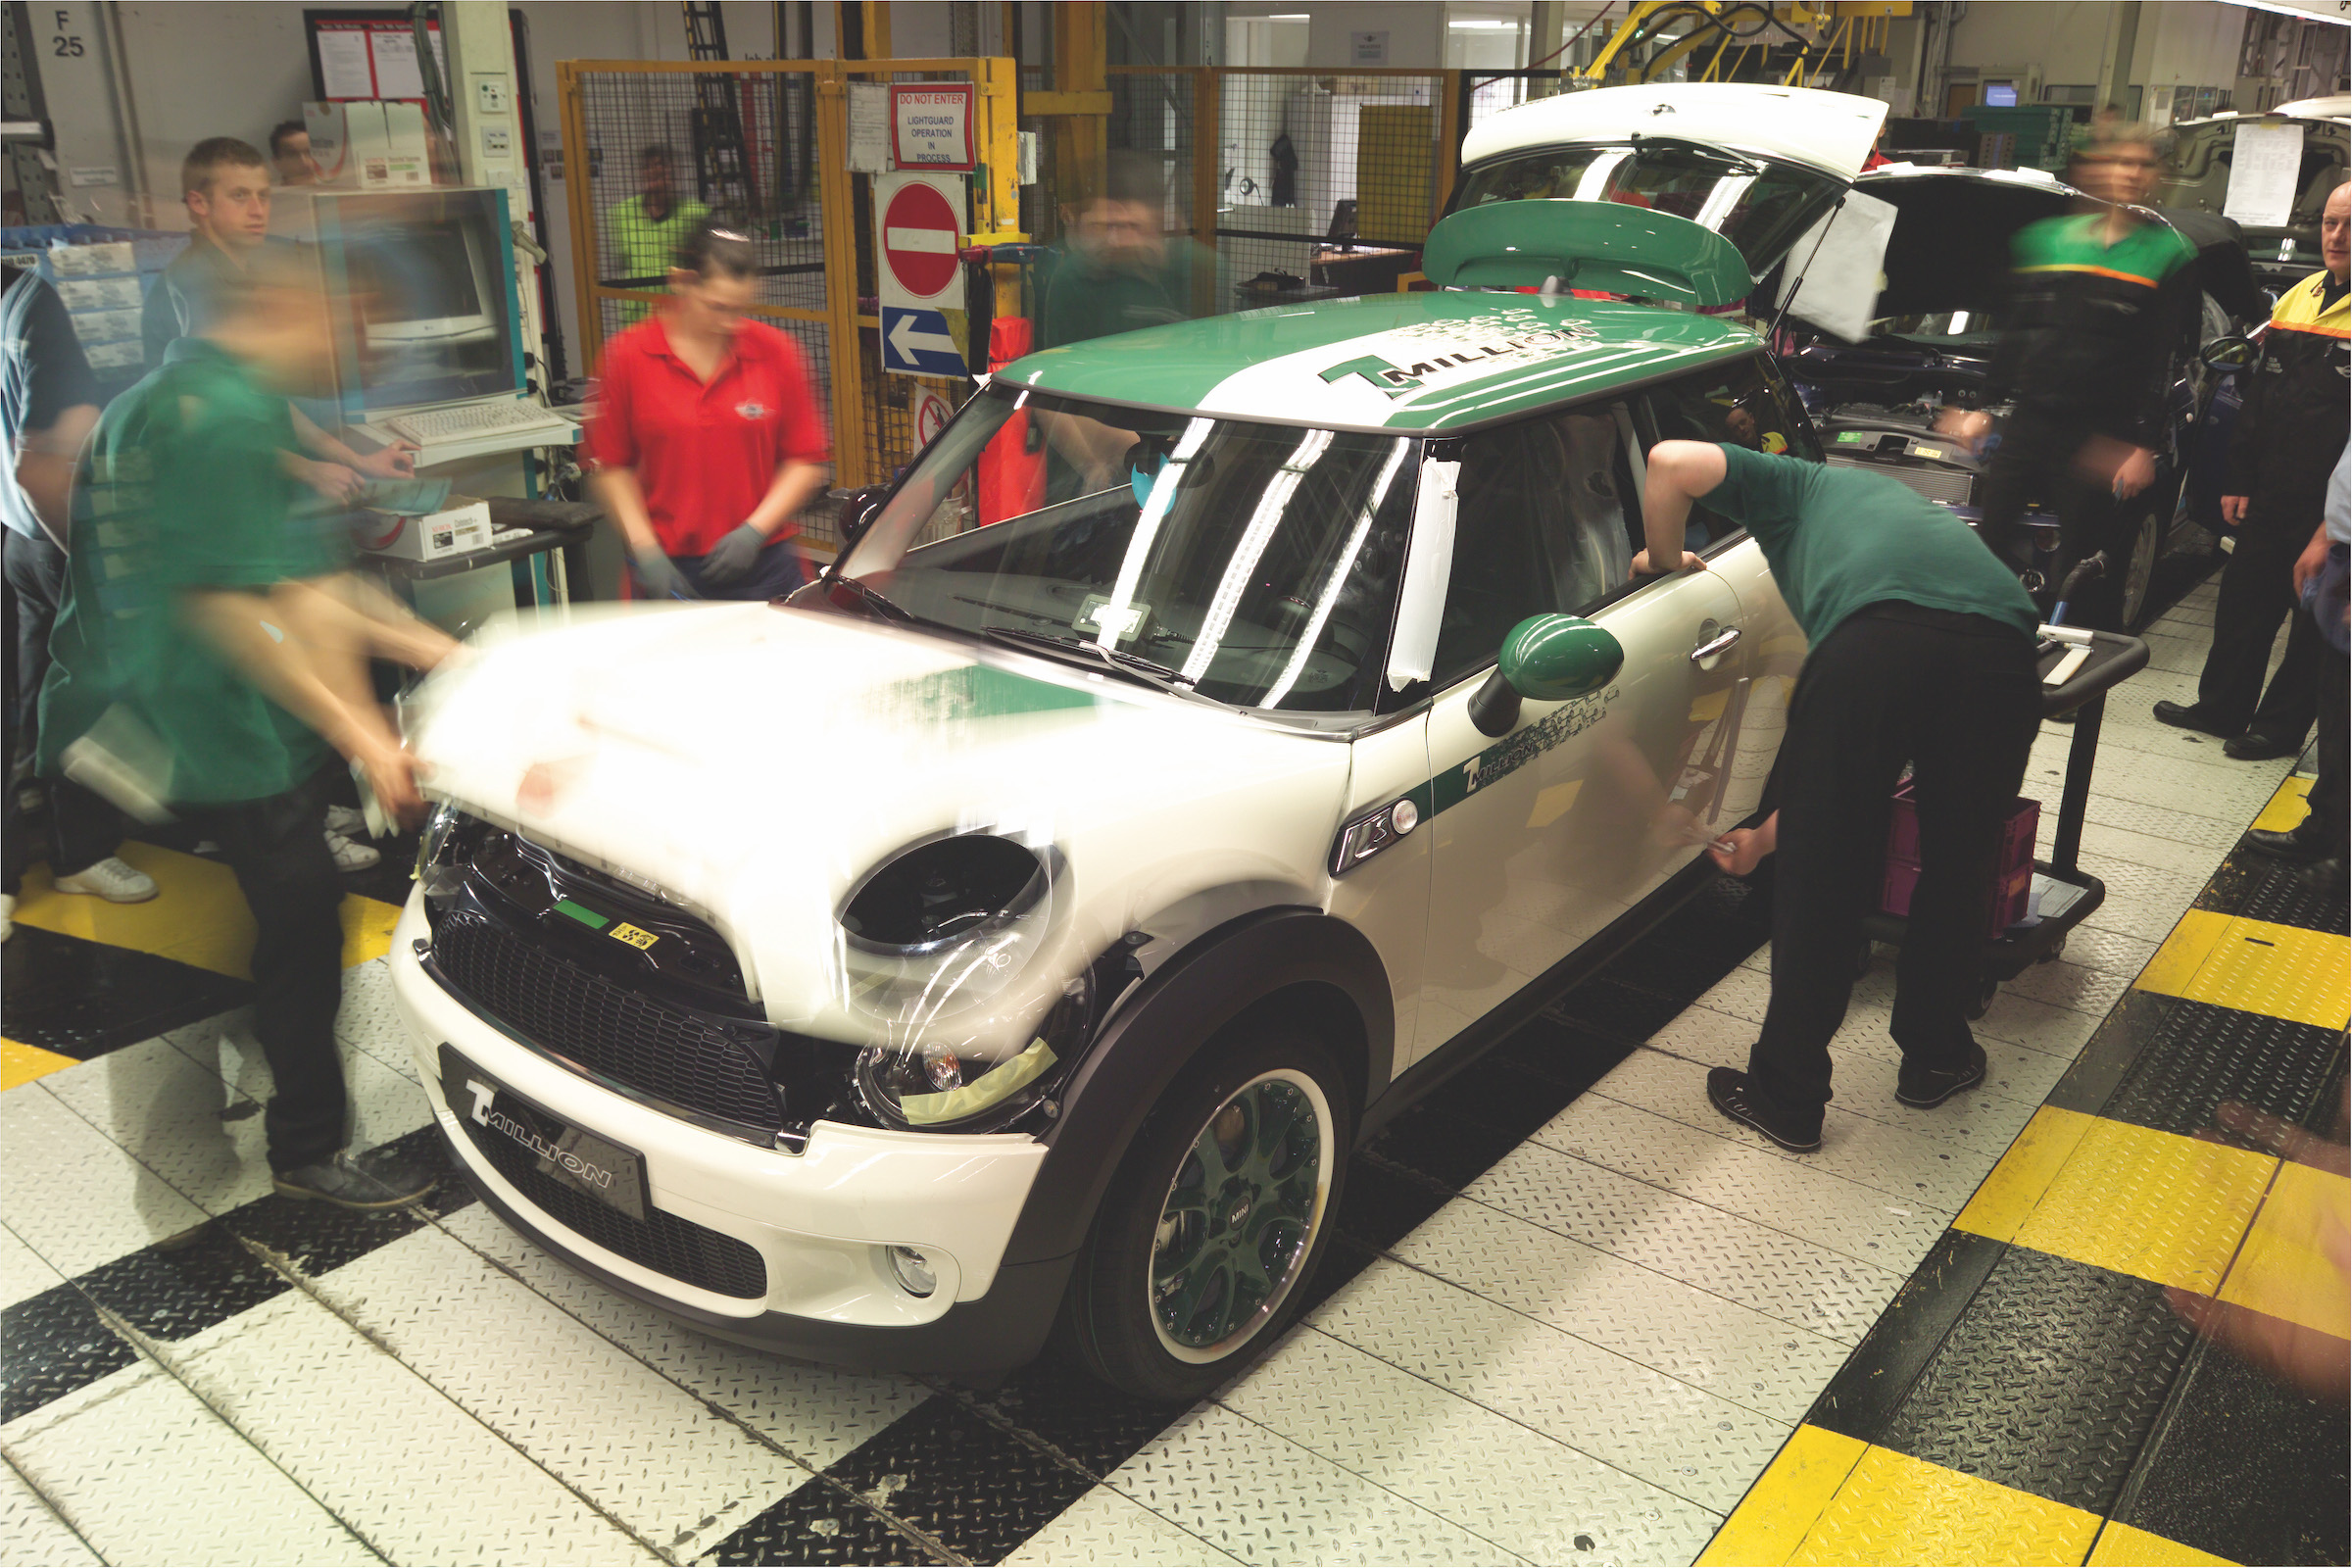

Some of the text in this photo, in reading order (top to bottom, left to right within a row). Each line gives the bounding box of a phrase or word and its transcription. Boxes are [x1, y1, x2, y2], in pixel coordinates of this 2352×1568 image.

[55, 10, 69, 30] F
[53, 35, 84, 58] 25
[900, 93, 963, 105] DO NOT ENTER
[907, 116, 955, 125] LIGHTGUARD
[911, 128, 953, 138] OPERATION
[927, 141, 936, 150] IN
[916, 153, 952, 164] PROCESS
[1231, 1203, 1249, 1224] MINI
